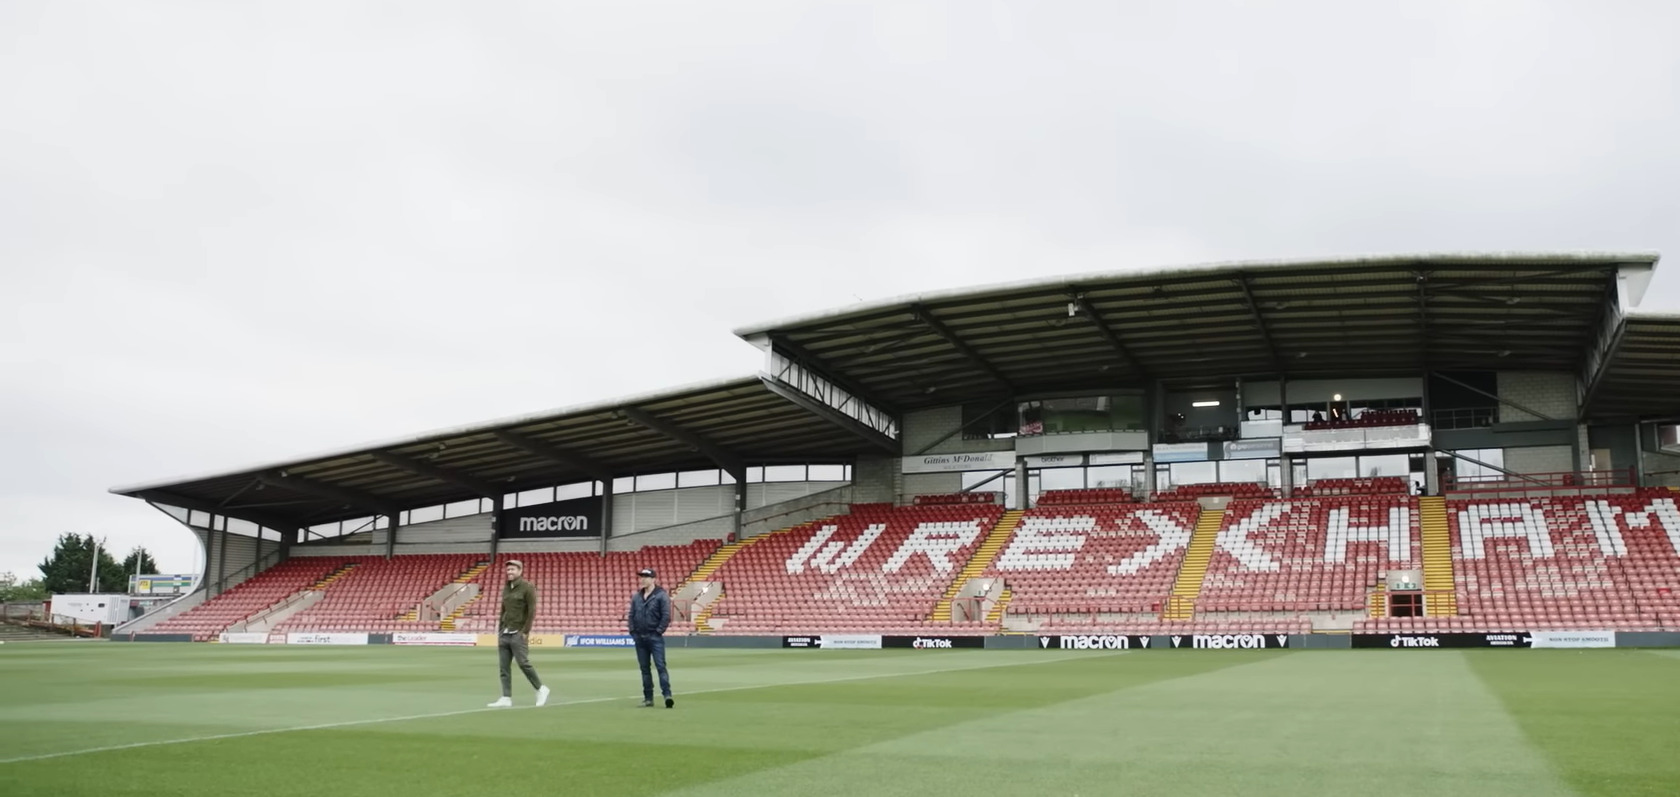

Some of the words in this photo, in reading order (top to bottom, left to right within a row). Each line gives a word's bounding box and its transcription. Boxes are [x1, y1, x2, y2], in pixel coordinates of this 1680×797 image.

[923, 456, 950, 465] Gittins
[519, 515, 588, 532] macron
[580, 637, 594, 645] IFOR
[595, 637, 625, 645] WILLIAMS
[923, 638, 952, 648] TikTok
[1060, 635, 1129, 649] macron
[1193, 634, 1266, 649] macron
[1402, 636, 1439, 647] TikTok
